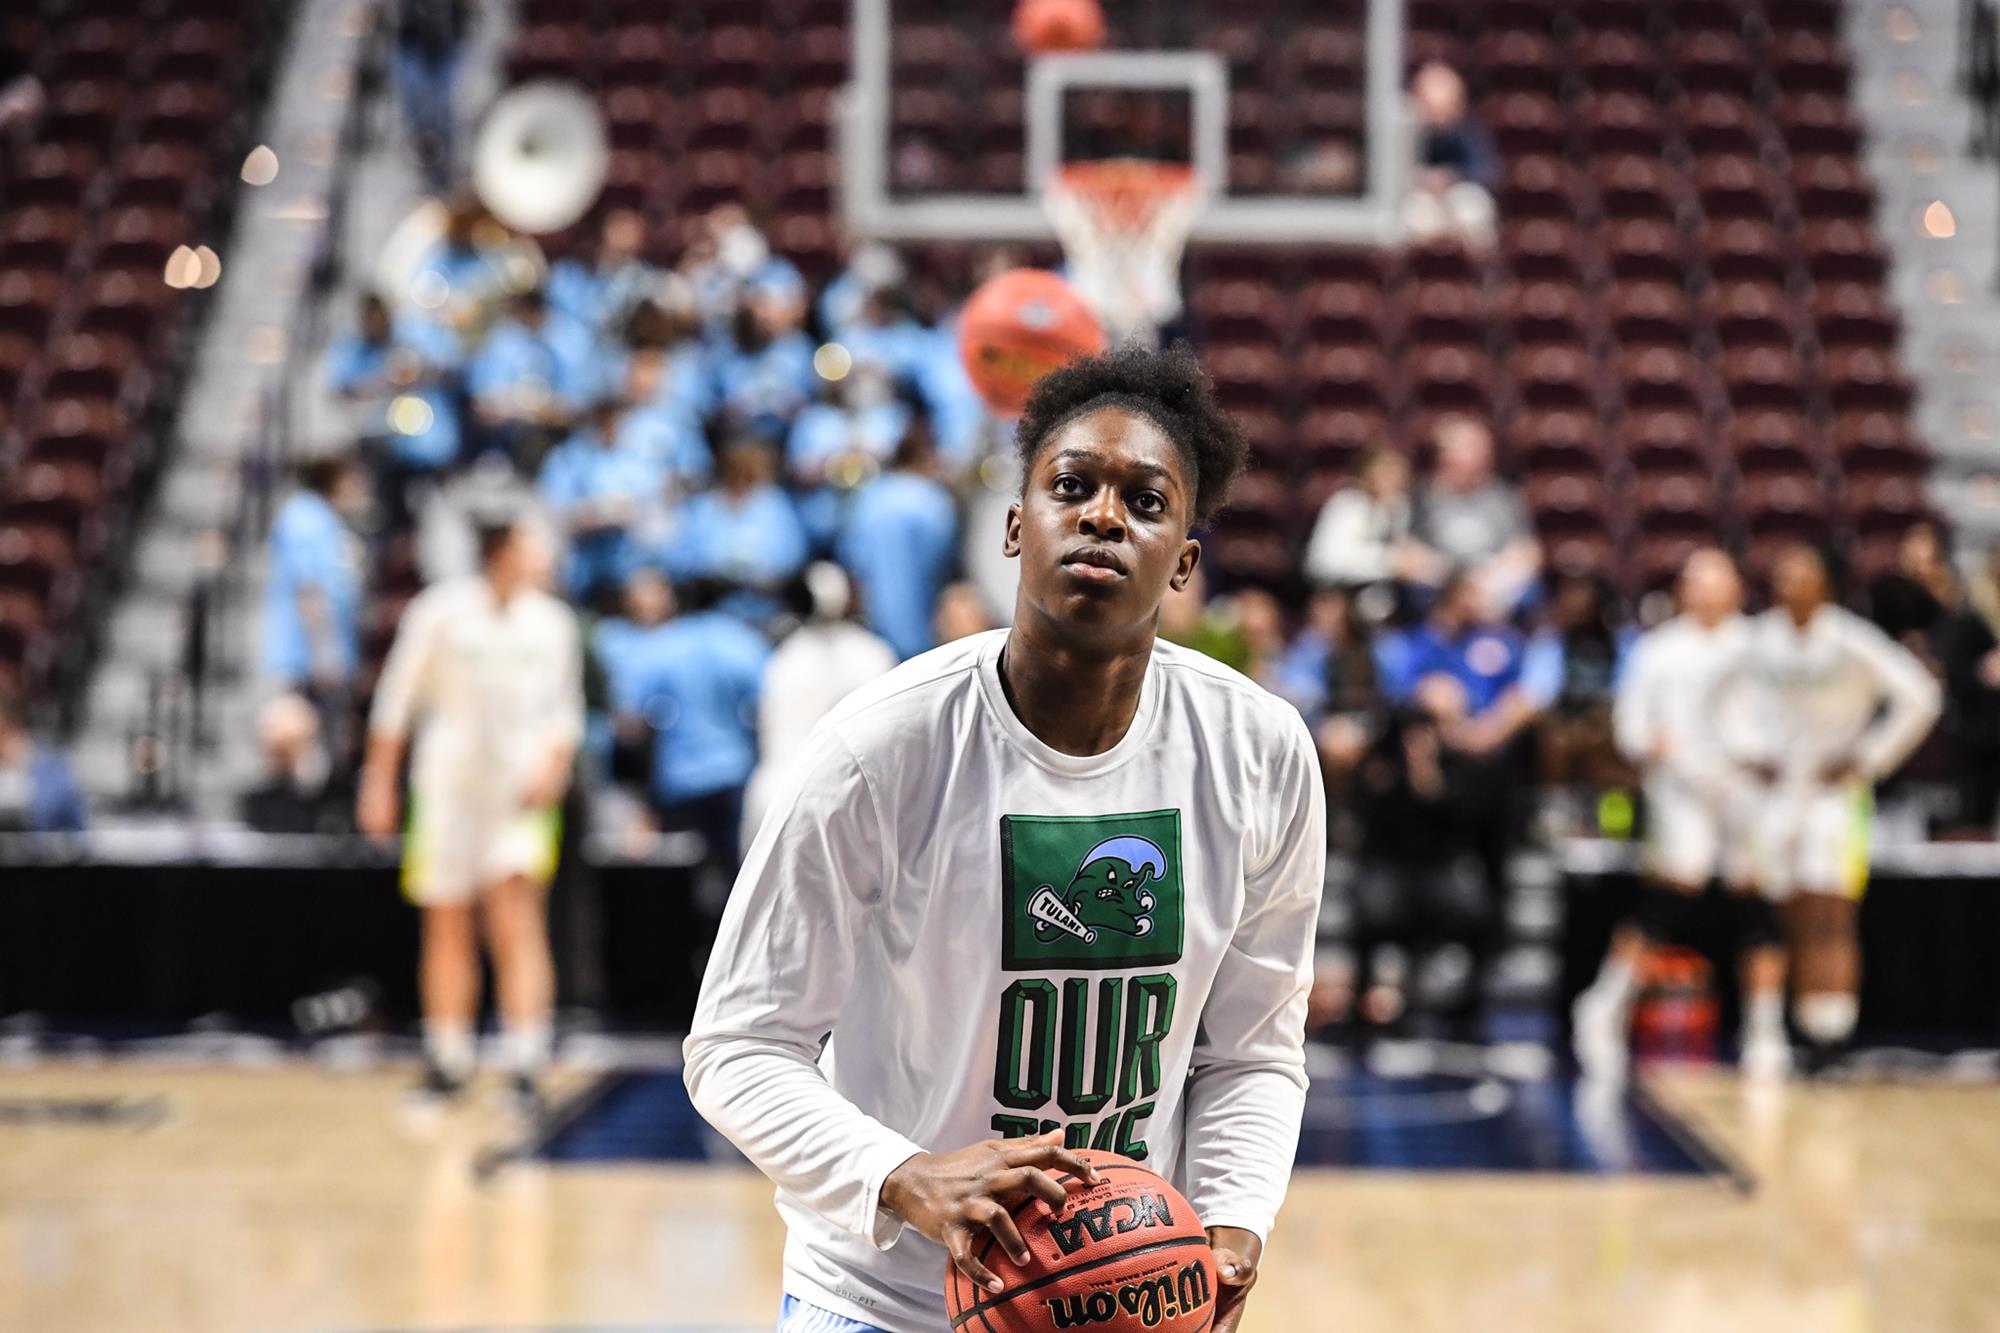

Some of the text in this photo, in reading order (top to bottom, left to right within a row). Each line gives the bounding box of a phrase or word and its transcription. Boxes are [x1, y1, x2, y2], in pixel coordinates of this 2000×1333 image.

[1040, 897, 1081, 932] TULANE
[994, 973, 1177, 1116] OUR
[1049, 1193, 1174, 1255] NCAA
[835, 1285, 877, 1306] DRI-FIT
[1047, 1259, 1211, 1330] Wilson
